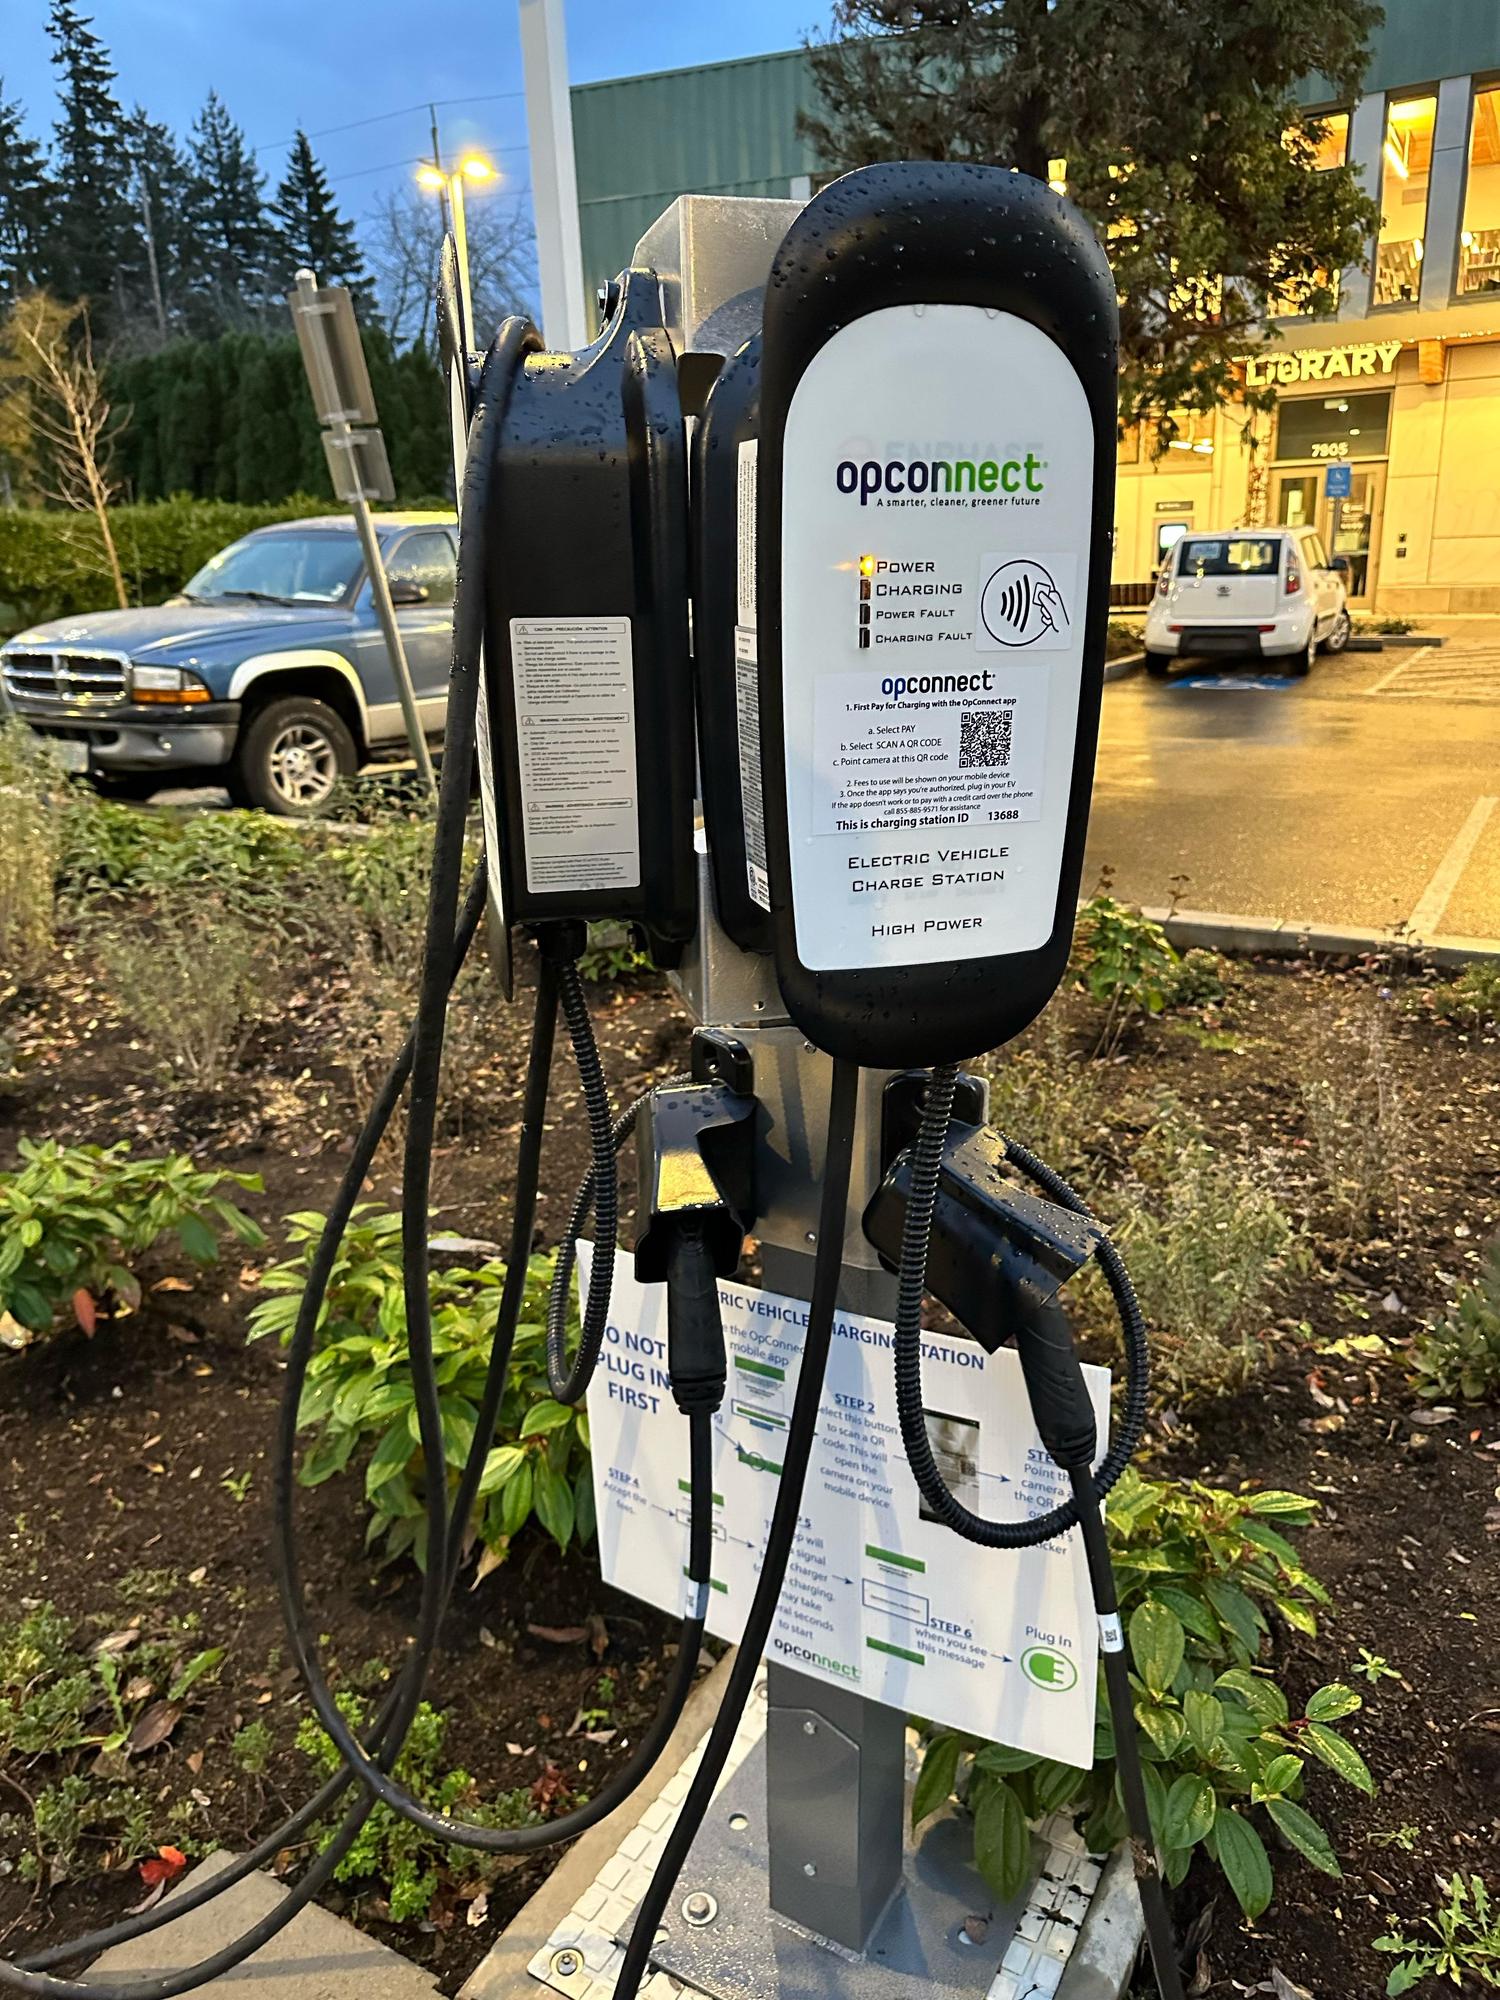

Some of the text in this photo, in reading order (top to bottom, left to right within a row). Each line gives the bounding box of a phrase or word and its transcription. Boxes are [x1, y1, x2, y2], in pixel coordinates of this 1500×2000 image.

[1246, 343, 1402, 386] LIBRARY
[836, 453, 1045, 506] opconnect
[877, 496, 1040, 508] A smarter, cleaner, greener future
[876, 561, 935, 573] POWER
[876, 584, 962, 596] CHARGING
[876, 609, 955, 619] POWER FAULT
[875, 632, 973, 643] CHARGING FAULT
[881, 670, 993, 701] opconnect
[853, 703, 870, 711] First
[871, 702, 884, 711] Pay
[885, 701, 896, 709] for
[897, 700, 930, 710] Charging
[931, 699, 947, 707] with
[962, 698, 1002, 707] OpConnect
[1003, 698, 1017, 706] app
[876, 726, 900, 734] Select
[901, 725, 916, 733] PAY
[840, 738, 942, 751] b. Select SCAN A QR CODE
[841, 757, 861, 766] Point
[862, 757, 890, 765] camera
[892, 755, 900, 763] at
[901, 755, 915, 763] this
[917, 753, 928, 762] QR
[929, 753, 949, 761] code
[948, 775, 964, 783] your
[878, 789, 892, 797] app
[967, 782, 982, 791] plug
[991, 782, 1006, 790] your
[888, 798, 903, 806] work
[920, 797, 932, 805] pay
[933, 795, 947, 803] with
[953, 794, 971, 802] credit
[972, 793, 986, 801] card
[1001, 791, 1012, 799] the
[1013, 790, 1033, 799] phone
[949, 803, 981, 811] assistance
[836, 810, 1019, 830] This is charging station ID 13688
[848, 847, 1009, 869] ELECTRIC VEHICLE
[852, 870, 1005, 892] CHARGE STATION
[872, 917, 983, 937] HIGH POWER
[606, 1326, 666, 1359] O NOT
[730, 1325, 747, 1338] the
[749, 1330, 804, 1355] OpConnec
[746, 1298, 810, 1327] VEHICLE
[920, 1343, 984, 1370] TATION
[730, 1341, 790, 1367] mobile app
[650, 1368, 672, 1391] IN
[608, 1381, 660, 1414] FIRST
[834, 1393, 875, 1412] STEP 2
[819, 1406, 898, 1435] elect this button
[827, 1423, 837, 1433] to
[839, 1427, 860, 1439] scan
[870, 1435, 885, 1447] QR
[849, 1443, 869, 1458] This
[834, 1456, 878, 1475] open the
[1024, 1463, 1070, 1482] Point th
[820, 1466, 893, 1495] camera on your
[1021, 1479, 1064, 1496] camera
[824, 1482, 890, 1509] mobile device
[1014, 1491, 1033, 1504] the
[1036, 1495, 1054, 1509] QR
[806, 1537, 824, 1548] will
[1036, 1542, 1067, 1555] icker
[797, 1547, 826, 1566] signal
[789, 1562, 828, 1583] charger
[801, 1596, 823, 1612] take
[794, 1608, 835, 1632] seconds
[931, 1617, 972, 1639] STEP 6
[791, 1623, 814, 1640] start
[1025, 1626, 1072, 1648] Plug In
[915, 1627, 988, 1657] when you see
[774, 1638, 861, 1679] opconnect
[917, 1640, 986, 1669] this message
